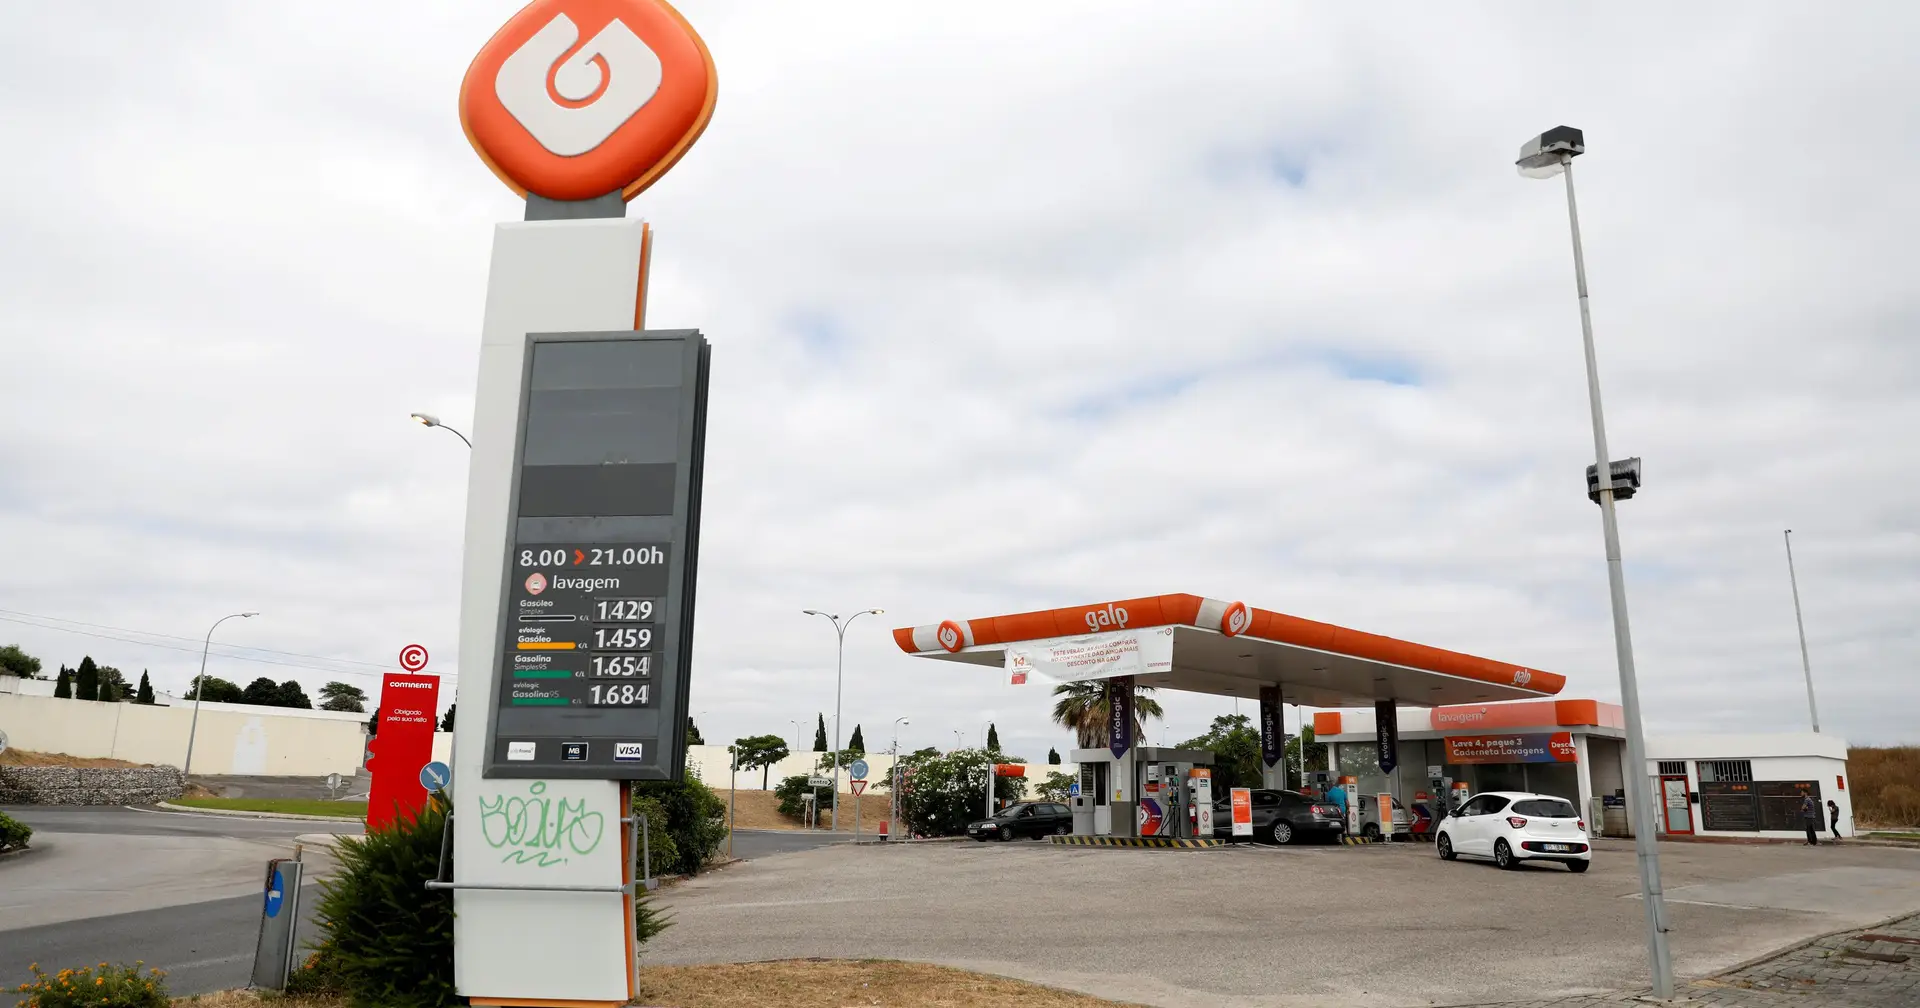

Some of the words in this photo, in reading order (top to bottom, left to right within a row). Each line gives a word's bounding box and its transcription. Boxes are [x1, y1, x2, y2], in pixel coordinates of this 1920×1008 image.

[520, 549, 567, 567] 8.00
[590, 545, 664, 565] 21.00h
[552, 575, 620, 592] lavagem
[520, 599, 554, 607] Gasóleo
[597, 600, 653, 620] 1.429
[1085, 603, 1129, 632] galp
[518, 635, 552, 643] Gasóleo
[595, 629, 652, 648] 1.459
[515, 654, 552, 663] Gasolina
[593, 656, 649, 676] 1.654
[1511, 668, 1531, 687] galp
[590, 684, 648, 705] 1.684
[394, 708, 422, 716] Obrigado
[1113, 696, 1123, 740] evologic
[1438, 711, 1483, 724] lavagem
[1264, 712, 1273, 750] evologic
[619, 746, 641, 755] VISA
[1380, 726, 1390, 759] evologic
[1452, 740, 1474, 748] Lave
[1486, 740, 1514, 749] pague
[1516, 738, 1523, 746] 3
[1453, 748, 1500, 757] Caderneta
[1501, 747, 1545, 757] Lavagens
